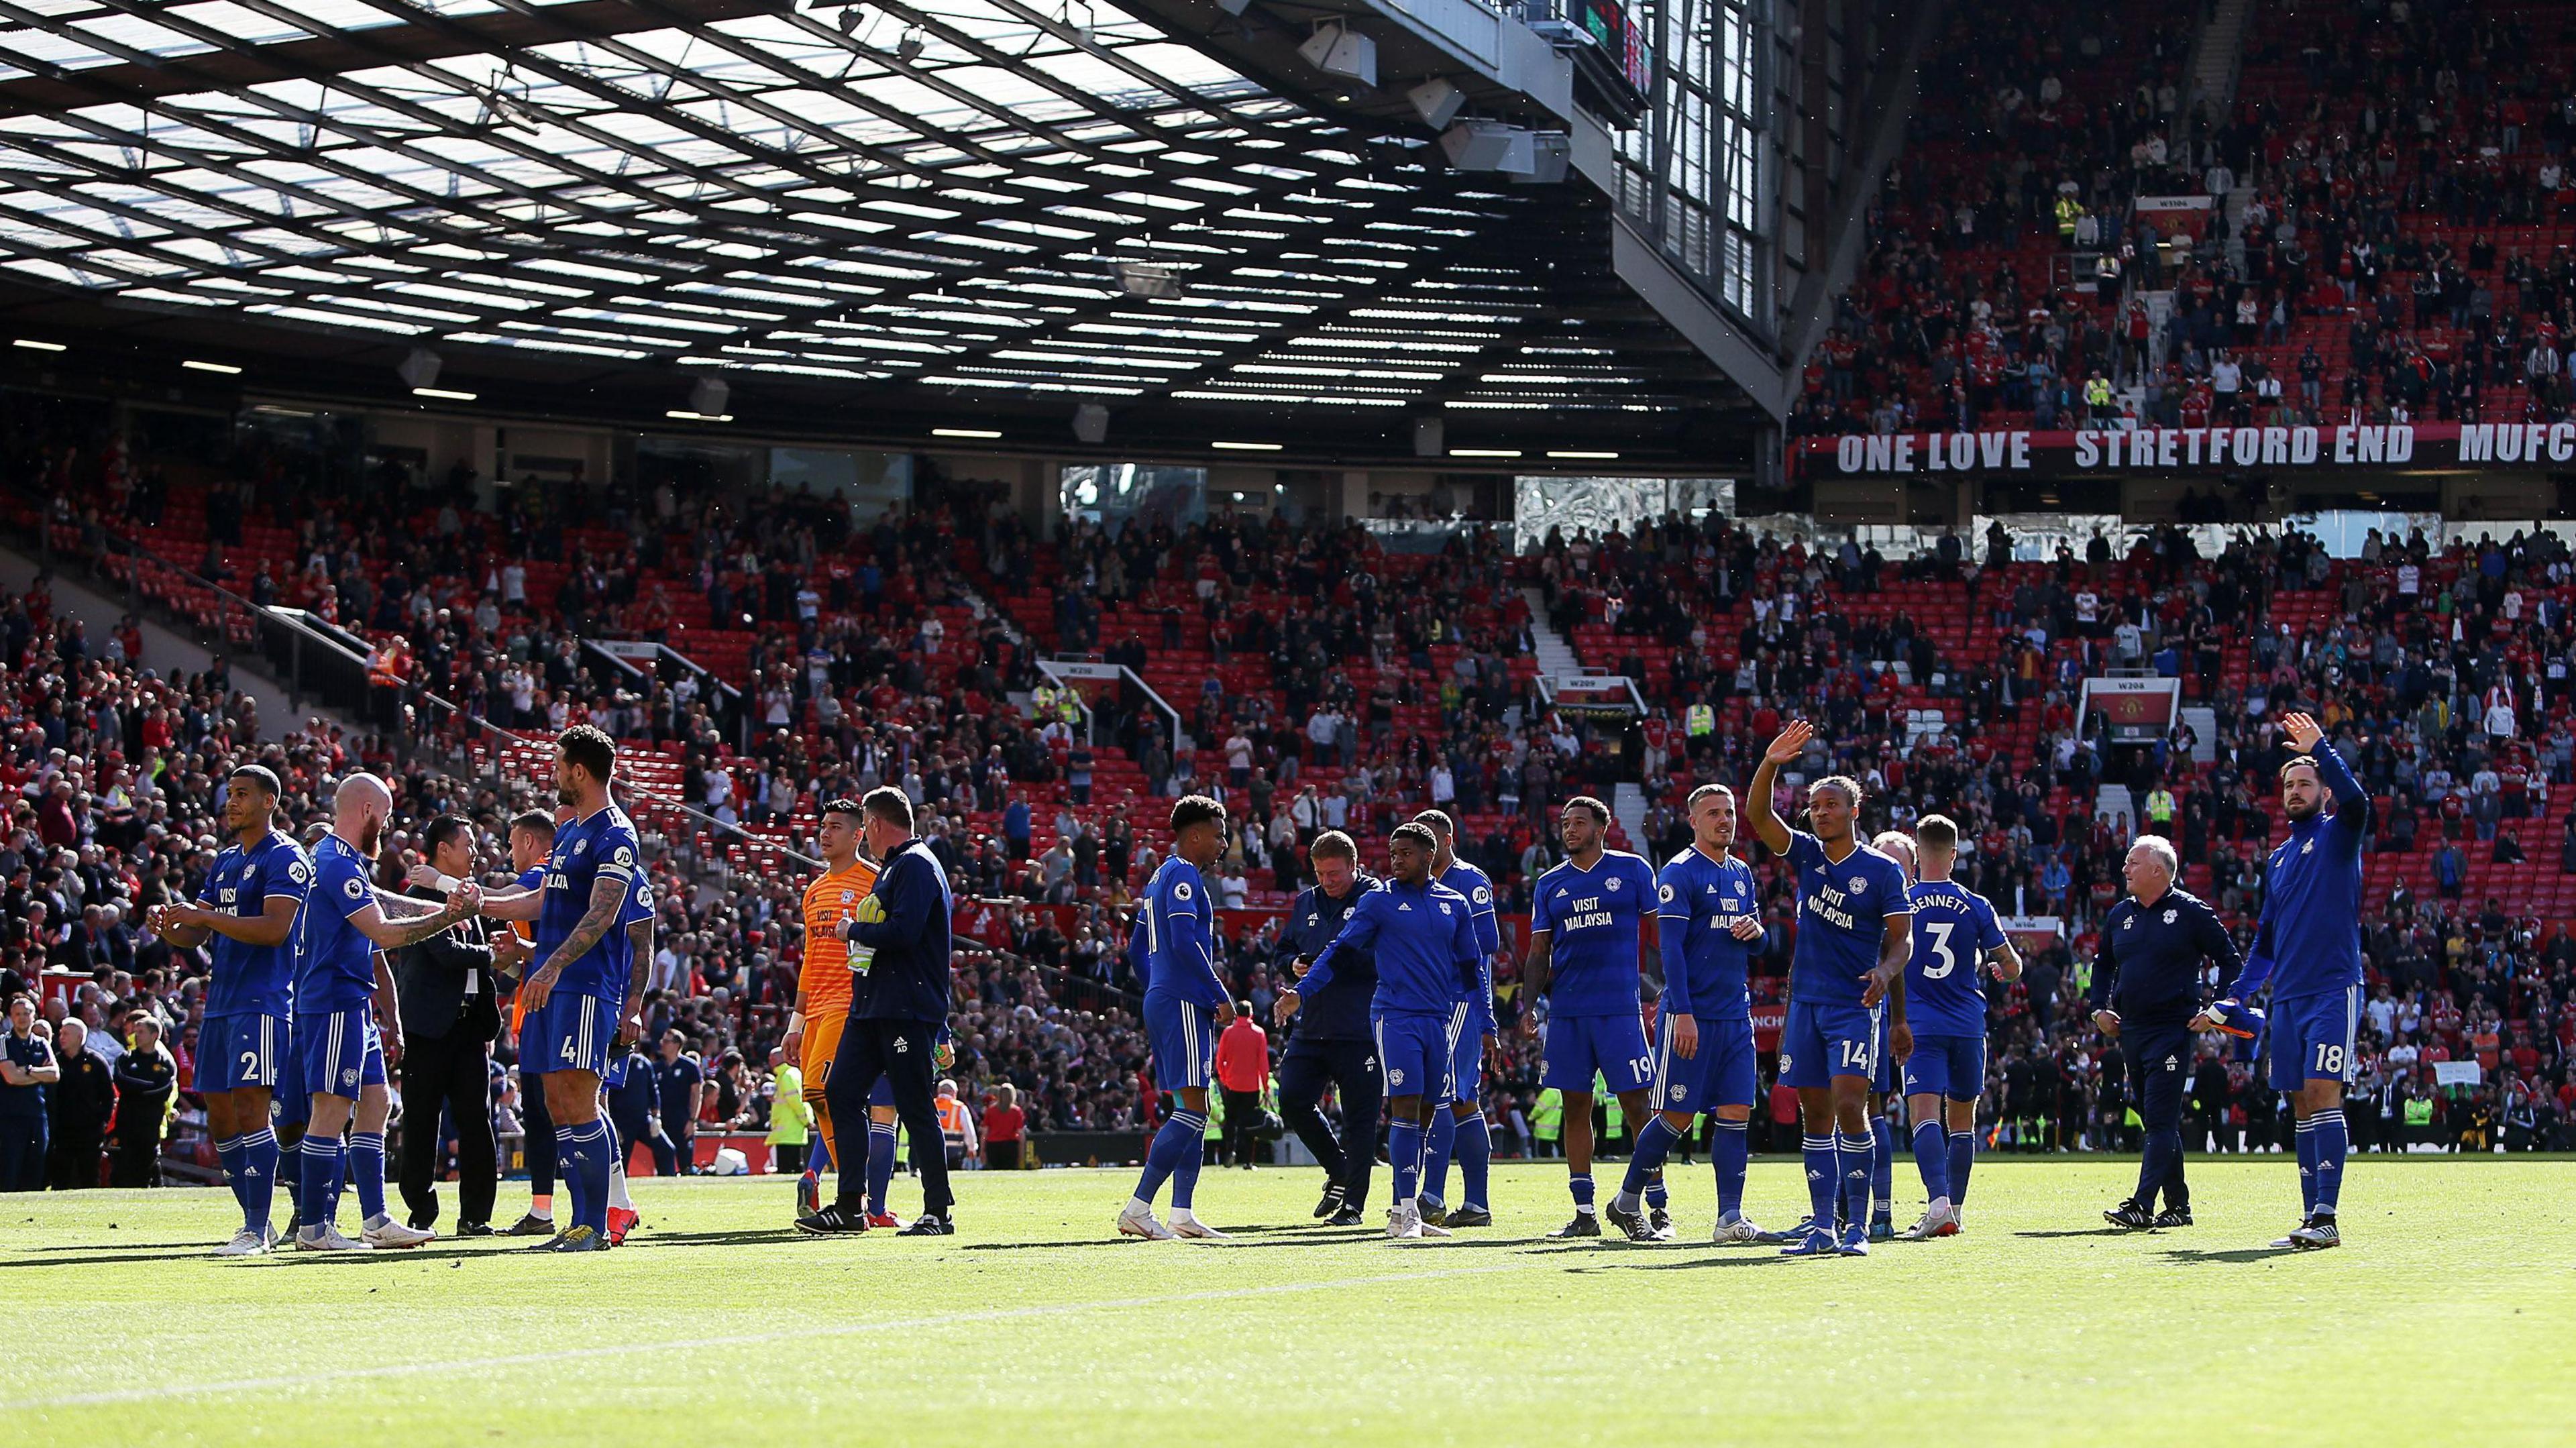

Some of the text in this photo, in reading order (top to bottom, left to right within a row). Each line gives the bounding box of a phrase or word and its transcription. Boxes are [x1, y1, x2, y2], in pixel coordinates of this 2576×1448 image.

[1838, 423, 2575, 472] ONE LOVE STRETFORD END MUFC
[616, 851, 631, 861] JD
[291, 867, 305, 879] JD
[640, 891, 649, 903] JD
[1476, 890, 1487, 901] JD
[1572, 896, 1599, 913] VISIT
[1719, 897, 1739, 912] VISIT
[1907, 894, 1971, 915] BENNETT
[817, 909, 833, 922] VISIT
[1564, 911, 1613, 932] MALAYSIA
[1923, 922, 1955, 979] 3
[560, 1036, 576, 1063] 4
[897, 1046, 908, 1054] AD
[1841, 1040, 1868, 1070] 14
[2316, 1043, 2344, 1073] 18
[241, 1051, 259, 1080] 2
[1629, 1056, 1652, 1084] 19
[1738, 1227, 1750, 1238] 90
